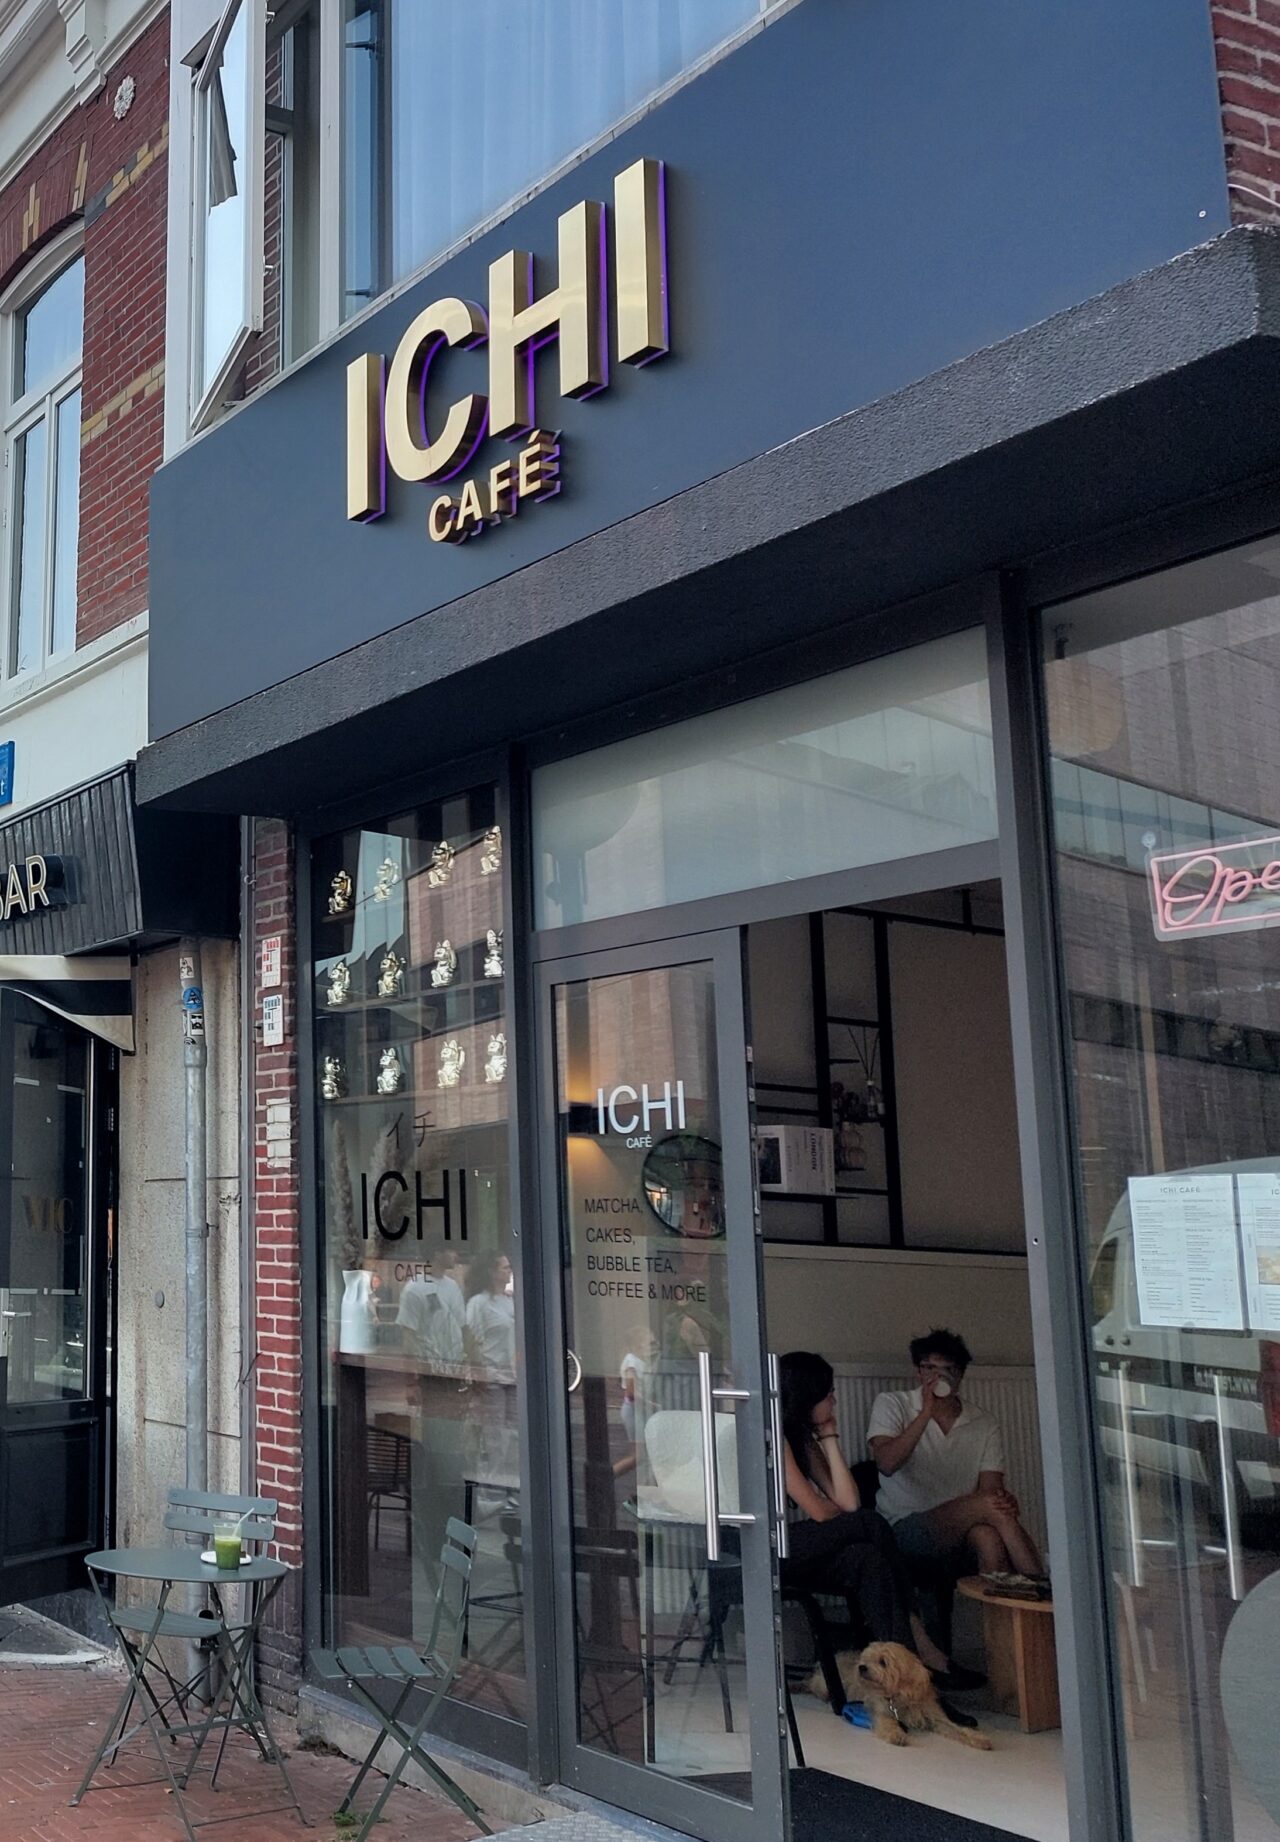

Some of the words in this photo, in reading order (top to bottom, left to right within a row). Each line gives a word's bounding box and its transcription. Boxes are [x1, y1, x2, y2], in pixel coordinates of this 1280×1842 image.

[347, 157, 660, 521] ICHI
[429, 430, 556, 543] CAFÉ
[596, 1080, 687, 1135] ICHI
[386, 1110, 436, 1149] イチ
[626, 1134, 653, 1149] CAFÉ
[361, 1168, 468, 1241] ICHI
[584, 1198, 644, 1214] MATCHA,
[586, 1227, 636, 1246] CAKES,
[395, 1260, 434, 1283] CAFÉ
[587, 1255, 641, 1272] BUBBLE
[645, 1257, 677, 1275] TEA,
[588, 1280, 644, 1299] COFFEE
[648, 1283, 657, 1300] &
[661, 1284, 707, 1303] MORE
